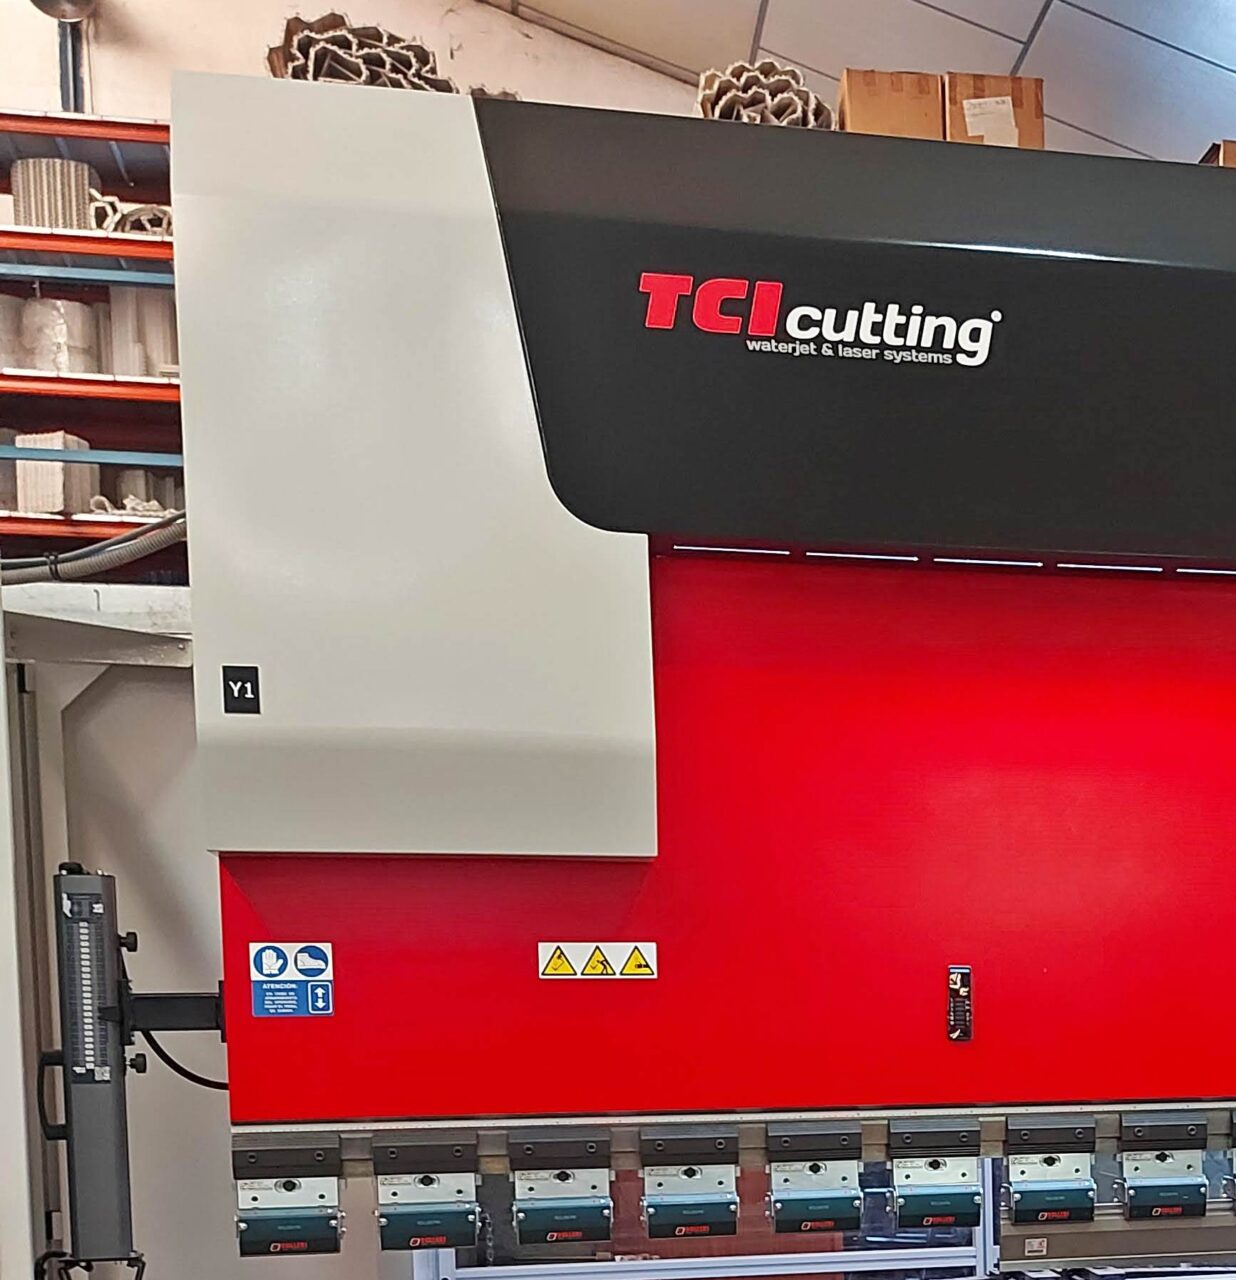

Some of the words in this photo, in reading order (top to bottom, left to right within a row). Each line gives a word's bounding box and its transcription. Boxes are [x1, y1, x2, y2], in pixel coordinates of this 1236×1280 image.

[639, 272, 783, 336] TCI
[785, 302, 995, 367] cutting
[746, 338, 817, 357] waterjet
[820, 342, 835, 357] &
[837, 345, 880, 360] laser
[883, 348, 953, 365] systems
[228, 680, 256, 699] Y1
